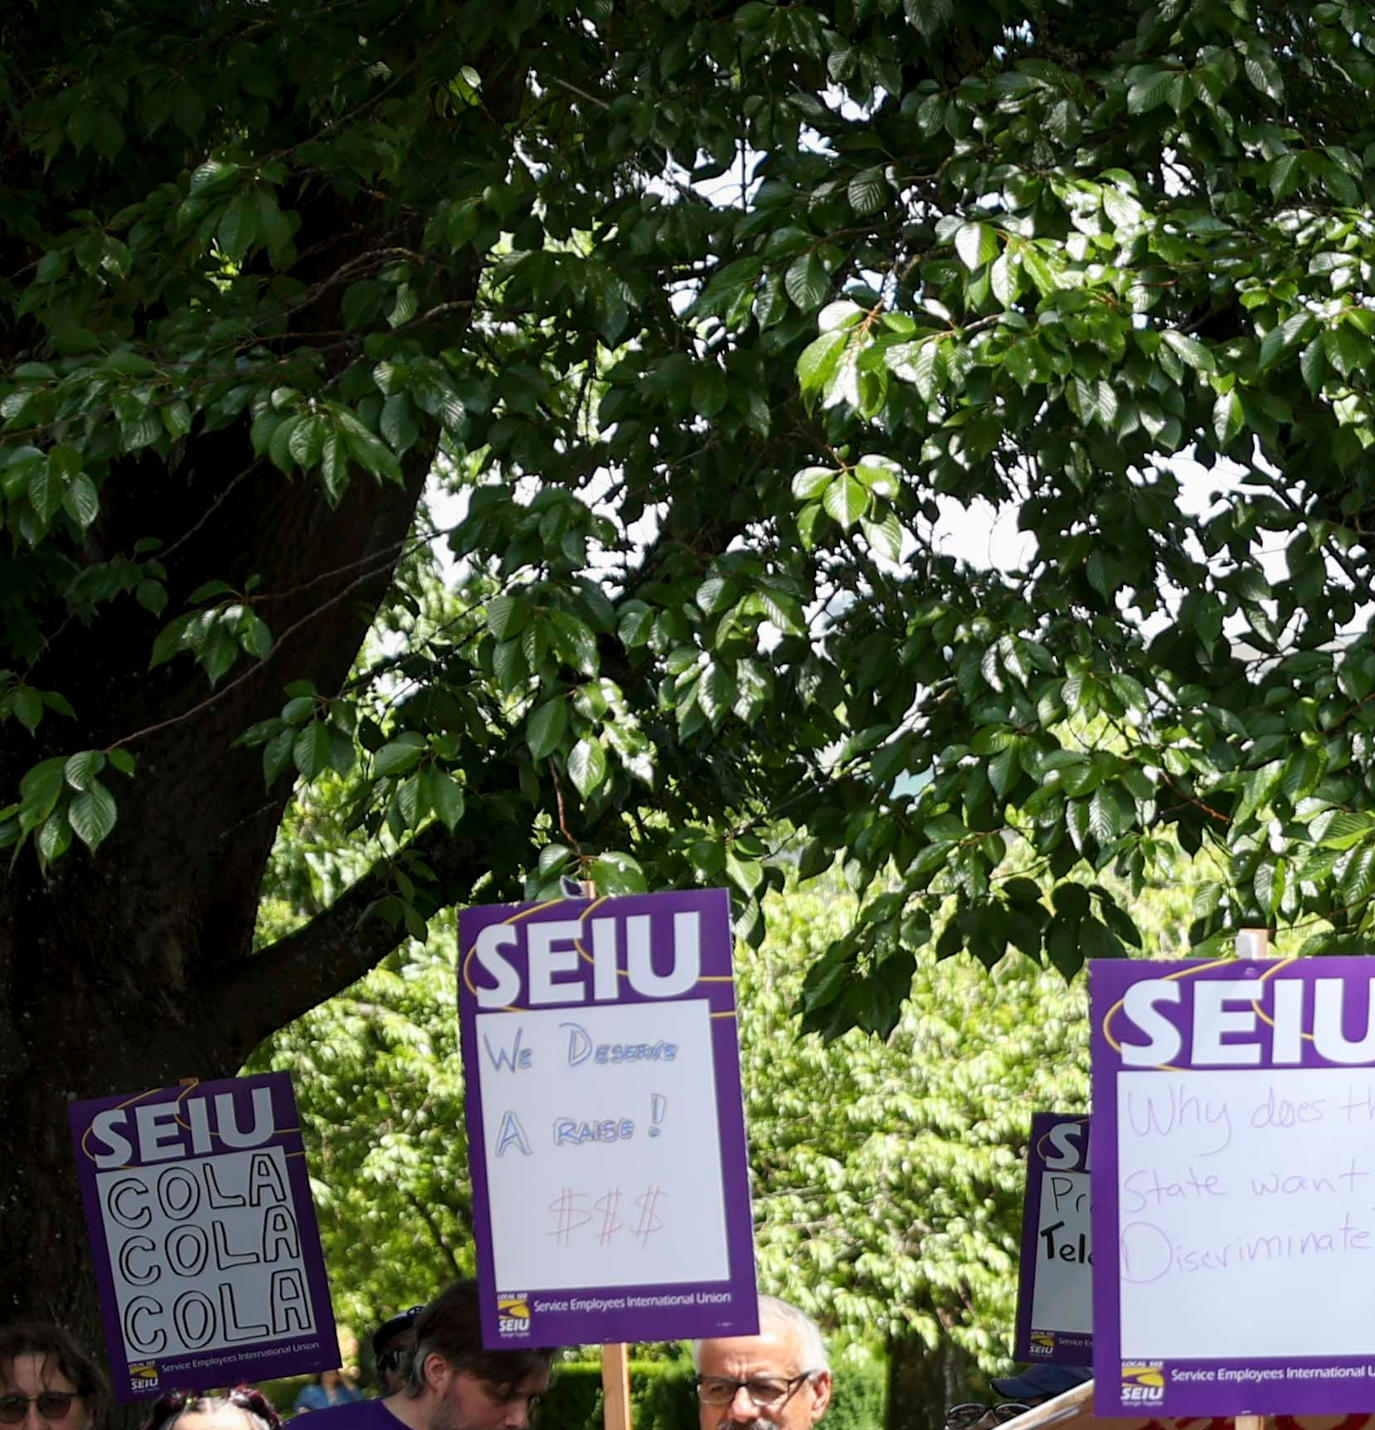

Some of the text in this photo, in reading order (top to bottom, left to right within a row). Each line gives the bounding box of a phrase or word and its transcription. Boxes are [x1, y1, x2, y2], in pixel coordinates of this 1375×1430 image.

[475, 911, 702, 1009] SEIU
[92, 1087, 276, 1169] SEIU
[495, 1111, 533, 1158] A
[1127, 1083, 1232, 1157] Why
[1250, 1086, 1326, 1128] does
[107, 1153, 287, 1230] COLA
[1123, 1165, 1228, 1214] State
[1250, 1158, 1368, 1197] want
[118, 1204, 300, 1287] COLA
[124, 1268, 313, 1354] COLA
[499, 1319, 530, 1332] SEIU
[533, 1292, 731, 1313] Service Employees International Union
[162, 1361, 192, 1374] Service
[193, 1354, 238, 1368] Employees
[238, 1343, 291, 1361] International
[292, 1341, 320, 1353] Union
[1171, 1369, 1214, 1382] Service
[1217, 1368, 1284, 1383] Employees
[1286, 1366, 1365, 1379] International
[131, 1377, 158, 1391] SEIU
[1120, 1387, 1164, 1400] SEIU
